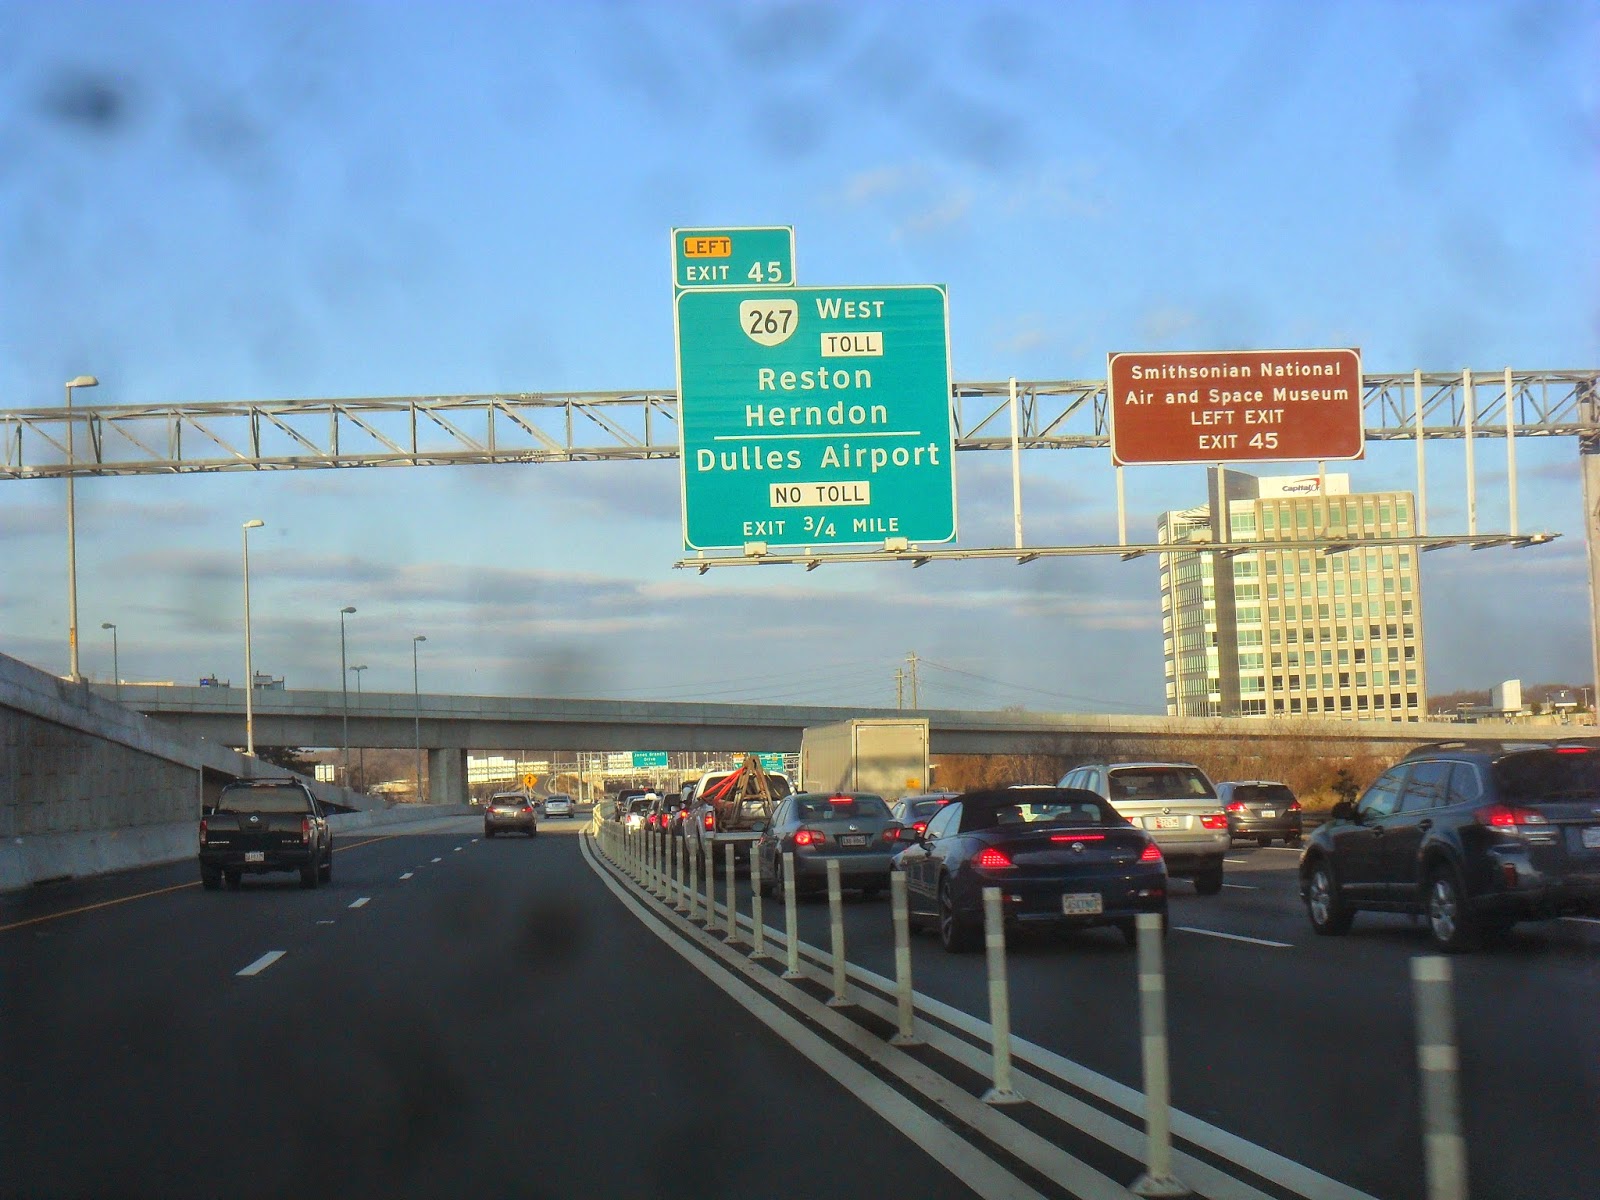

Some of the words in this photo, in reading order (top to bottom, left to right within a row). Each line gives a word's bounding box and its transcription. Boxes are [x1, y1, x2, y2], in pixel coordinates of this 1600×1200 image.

[684, 240, 730, 254] LEFT
[686, 265, 730, 281] EXIT
[747, 261, 783, 283] 45
[749, 309, 793, 334] 267
[815, 298, 885, 319] WEST
[827, 336, 877, 353] TOLL
[758, 366, 872, 391] Reston
[1131, 363, 1251, 380] Smithsonian
[1260, 361, 1341, 377] National
[1125, 390, 1154, 405] Air
[1165, 389, 1199, 404] and
[1209, 388, 1264, 406] Space
[1273, 387, 1349, 402] Museum
[745, 401, 888, 427] Herndon
[1190, 410, 1235, 426] LEFT
[1245, 409, 1285, 424] EXIT
[1199, 434, 1238, 449] EXIT
[1248, 432, 1279, 449] 45
[696, 446, 802, 472] Dulles
[820, 443, 940, 473] Airport
[775, 487, 801, 503] NO
[815, 485, 865, 502] TOLL
[743, 520, 786, 536] EXIT
[803, 516, 836, 537] 3/4
[853, 517, 899, 533] MILE
